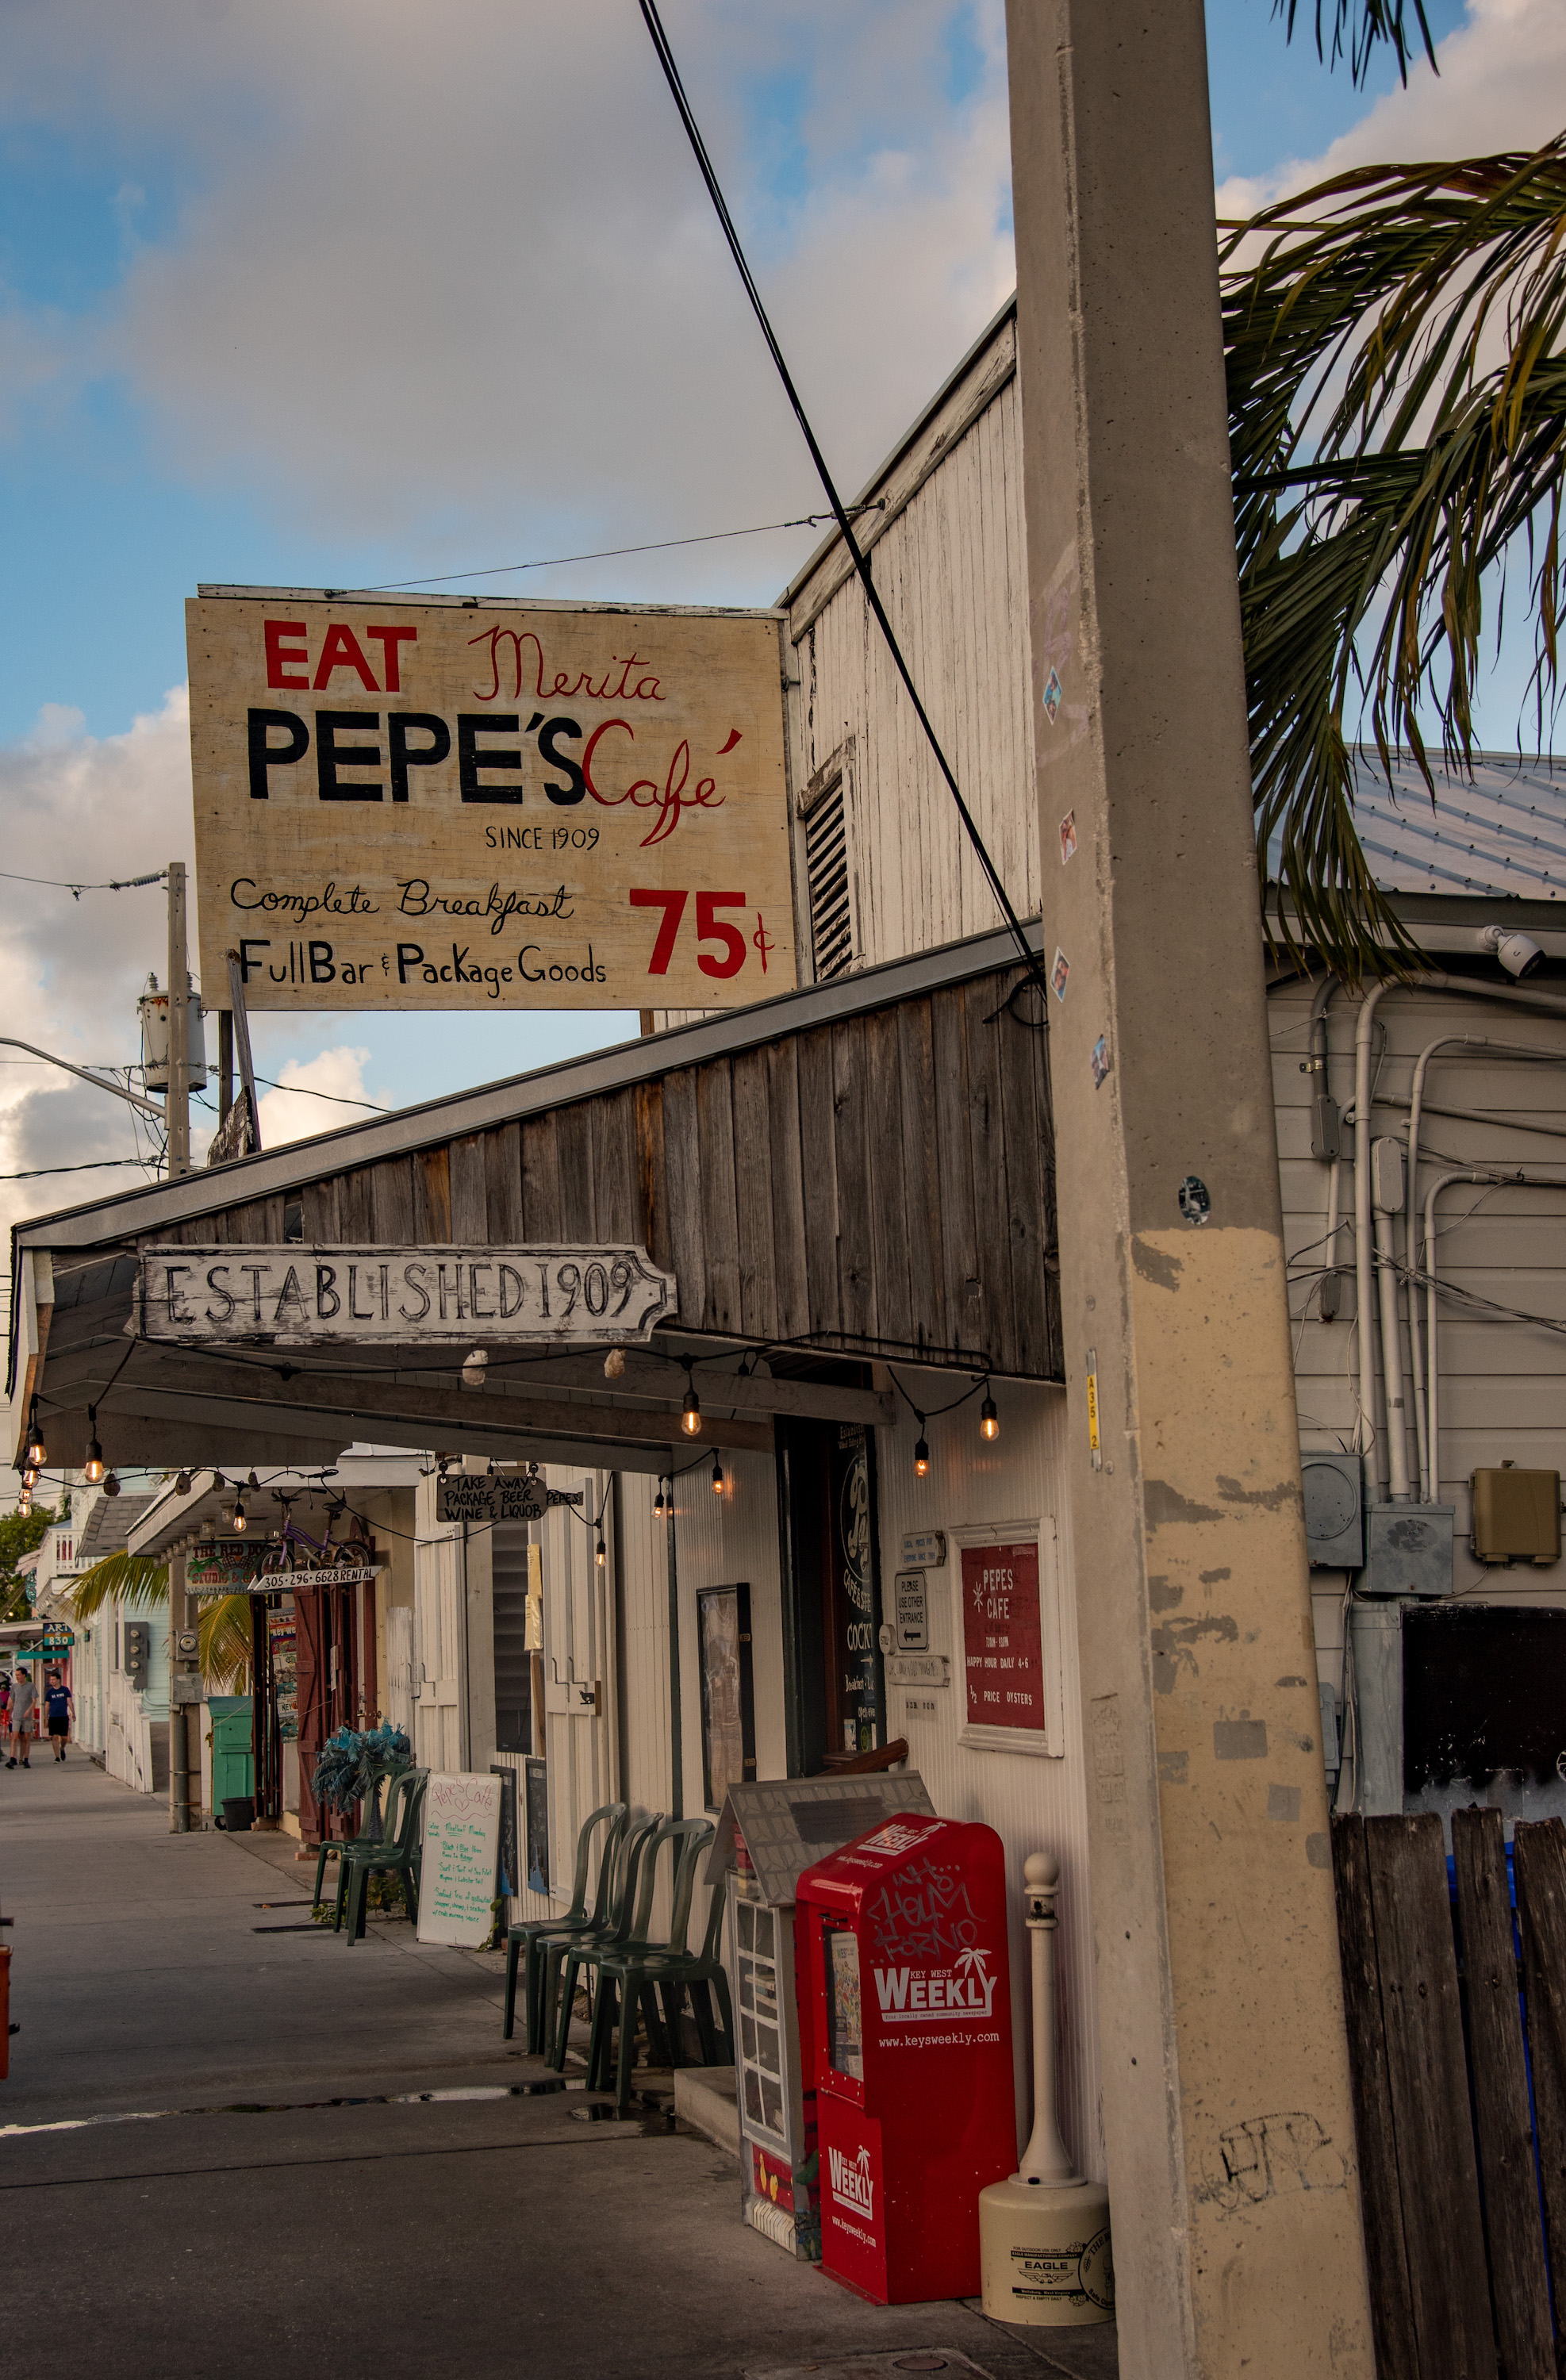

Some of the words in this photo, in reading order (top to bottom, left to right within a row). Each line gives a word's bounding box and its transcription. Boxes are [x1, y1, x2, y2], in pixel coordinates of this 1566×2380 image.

[263, 620, 416, 692] EAT
[468, 624, 666, 701] Merita
[248, 708, 586, 806] PEPE'S
[486, 827, 542, 849] SINCE
[552, 827, 600, 850] 1909
[231, 878, 379, 923] Complete
[397, 879, 574, 935] Breakfast
[518, 943, 606, 982] Goods
[166, 1264, 525, 1323] ESTABLISHED
[535, 1260, 635, 1319] 1909
[452, 1475, 486, 1491] TAKE
[493, 1476, 529, 1491] AWAY
[443, 1490, 496, 1507] PACKAGE
[500, 1489, 534, 1504] BEER
[445, 1507, 483, 1521] WINE
[489, 1507, 498, 1519] &
[501, 1503, 542, 1518] LIQUOR
[193, 1545, 216, 1558] THE
[220, 1543, 244, 1556] RED
[192, 1572, 228, 1584] STUDIO
[232, 1572, 240, 1583] &
[340, 1568, 374, 1581] RENTAL
[983, 1568, 1013, 1591] PEPES
[901, 1580, 919, 1592] PLEASE
[899, 1597, 908, 1607] USE
[908, 1596, 923, 1607] OTHER
[987, 1597, 1010, 1619] CAFE
[900, 1612, 923, 1624] ENTRANCE
[49, 1637, 68, 1645] 830
[967, 1656, 982, 1668] HAPPY
[985, 1656, 997, 1668] HOUR
[1000, 1656, 1015, 1669] DAILY
[1018, 1657, 1029, 1669] 4-6
[984, 1691, 1000, 1702] PRICE
[1006, 1691, 1032, 1706] OYSTERS
[910, 1971, 926, 1979] KEY
[931, 1969, 952, 1978] WEST
[873, 1967, 997, 2011] WEEKLY
[879, 2032, 1000, 2048] www.keysweekly.com
[828, 2145, 873, 2208] WEEKLY
[1088, 2236, 1104, 2255] THE
[1088, 2288, 1100, 2301] Safe
